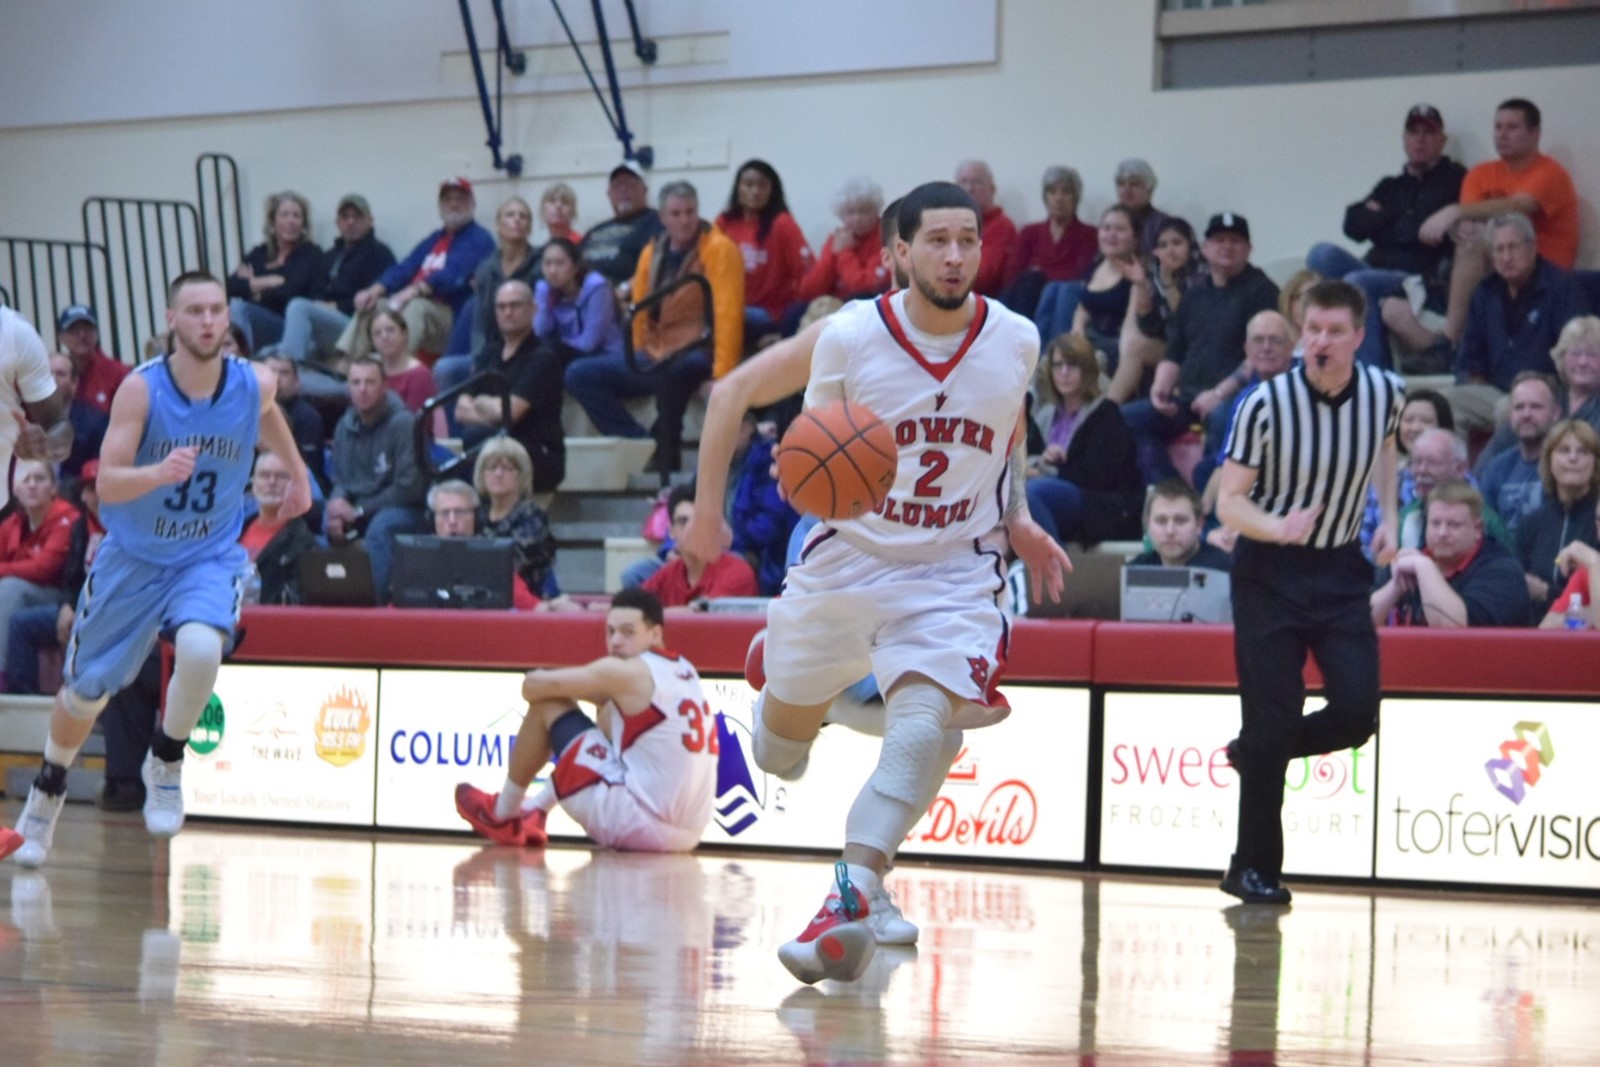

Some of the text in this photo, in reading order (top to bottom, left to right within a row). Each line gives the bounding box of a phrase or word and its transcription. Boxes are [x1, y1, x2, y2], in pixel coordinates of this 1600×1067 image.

[896, 417, 995, 454] OWER
[164, 470, 217, 514] 33
[914, 450, 949, 497] 2
[273, 746, 302, 762] WAVE
[390, 728, 512, 767] COLUM
[1111, 743, 1233, 788] swee
[221, 790, 257, 809] Locally
[262, 793, 302, 809] Owned
[306, 795, 350, 811] Stations
[921, 779, 1038, 847] Devils
[1110, 803, 1225, 829] FROZEN
[1285, 811, 1363, 836] GURT
